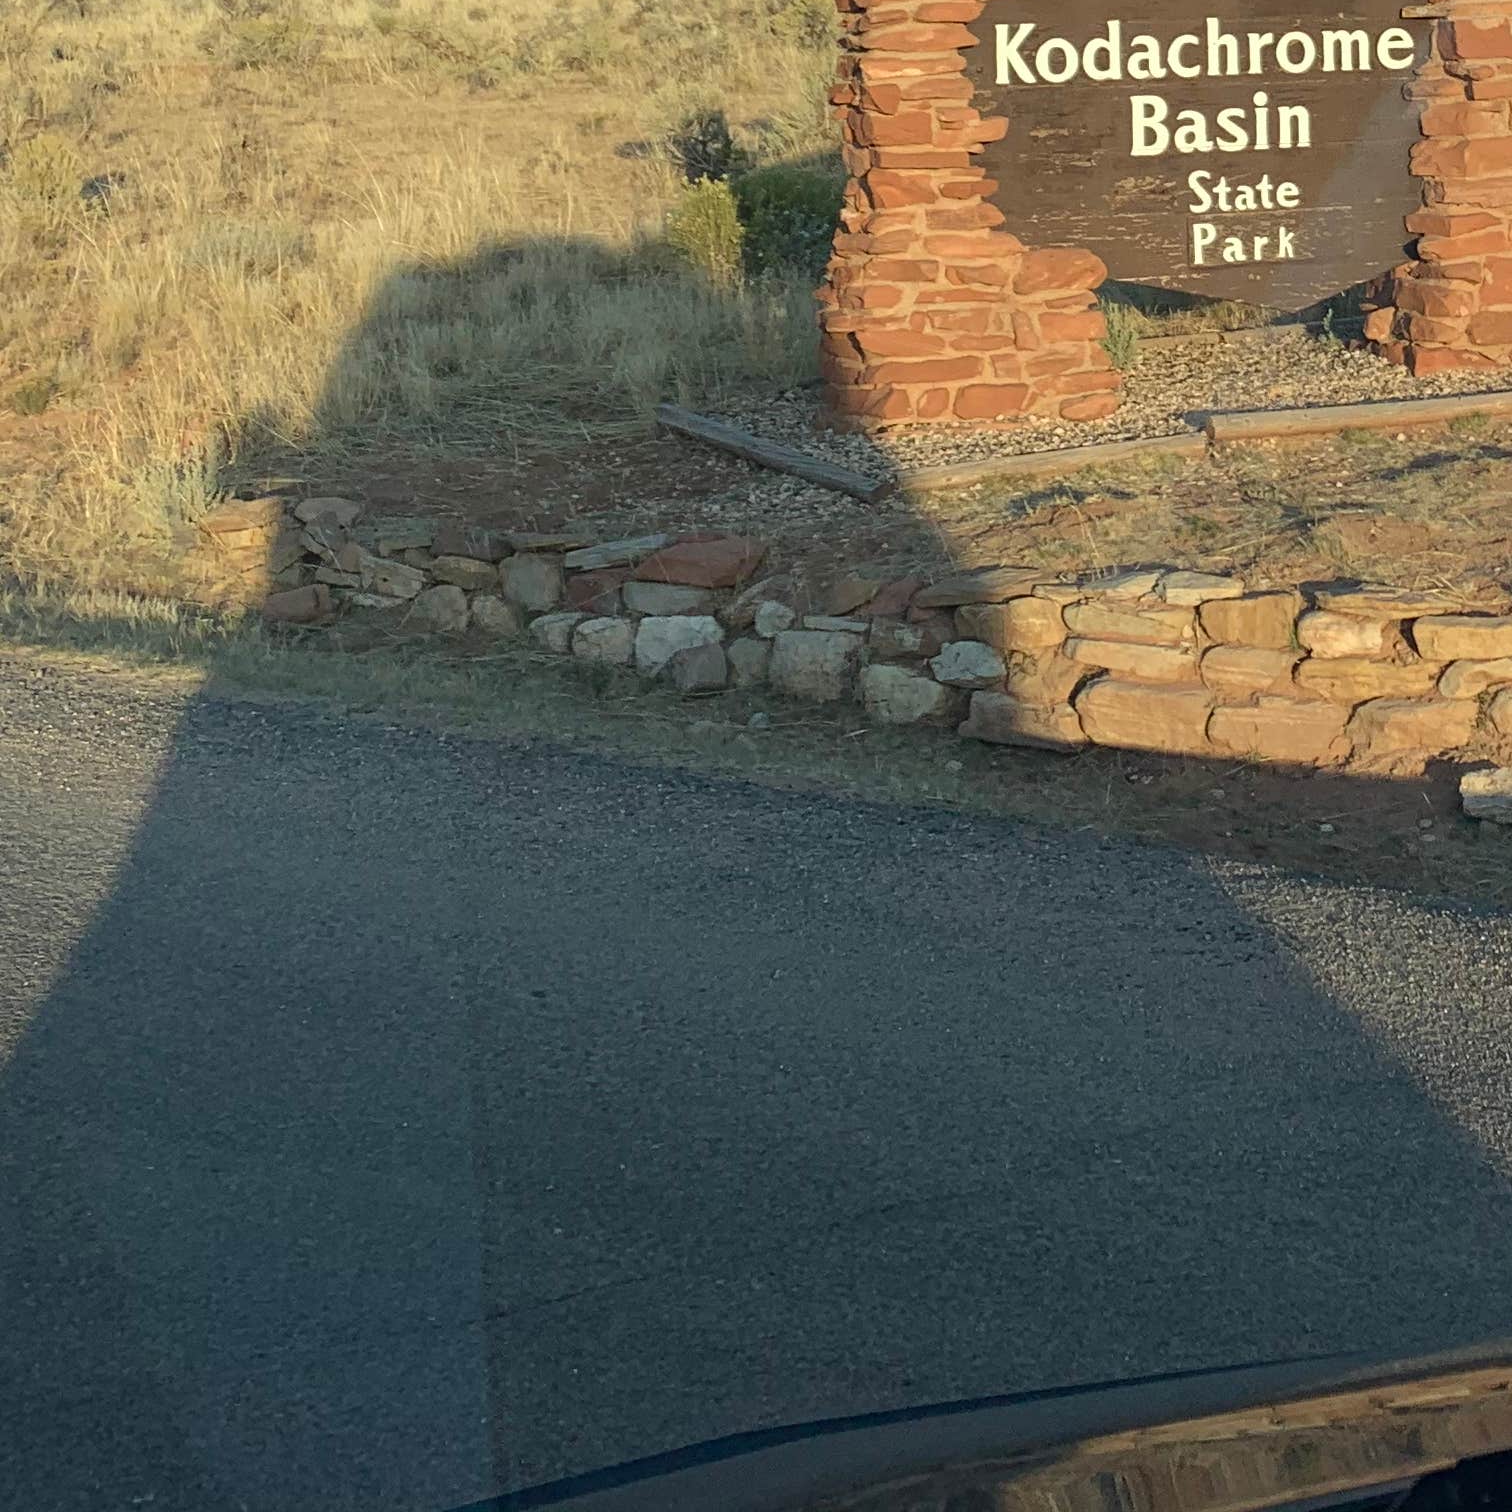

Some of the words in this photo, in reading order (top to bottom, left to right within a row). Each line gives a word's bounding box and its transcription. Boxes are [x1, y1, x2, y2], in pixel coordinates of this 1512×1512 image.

[994, 17, 1415, 85] Kodachrome
[1130, 91, 1312, 157] Basin
[1188, 170, 1300, 214] State
[1192, 222, 1295, 265] Park
